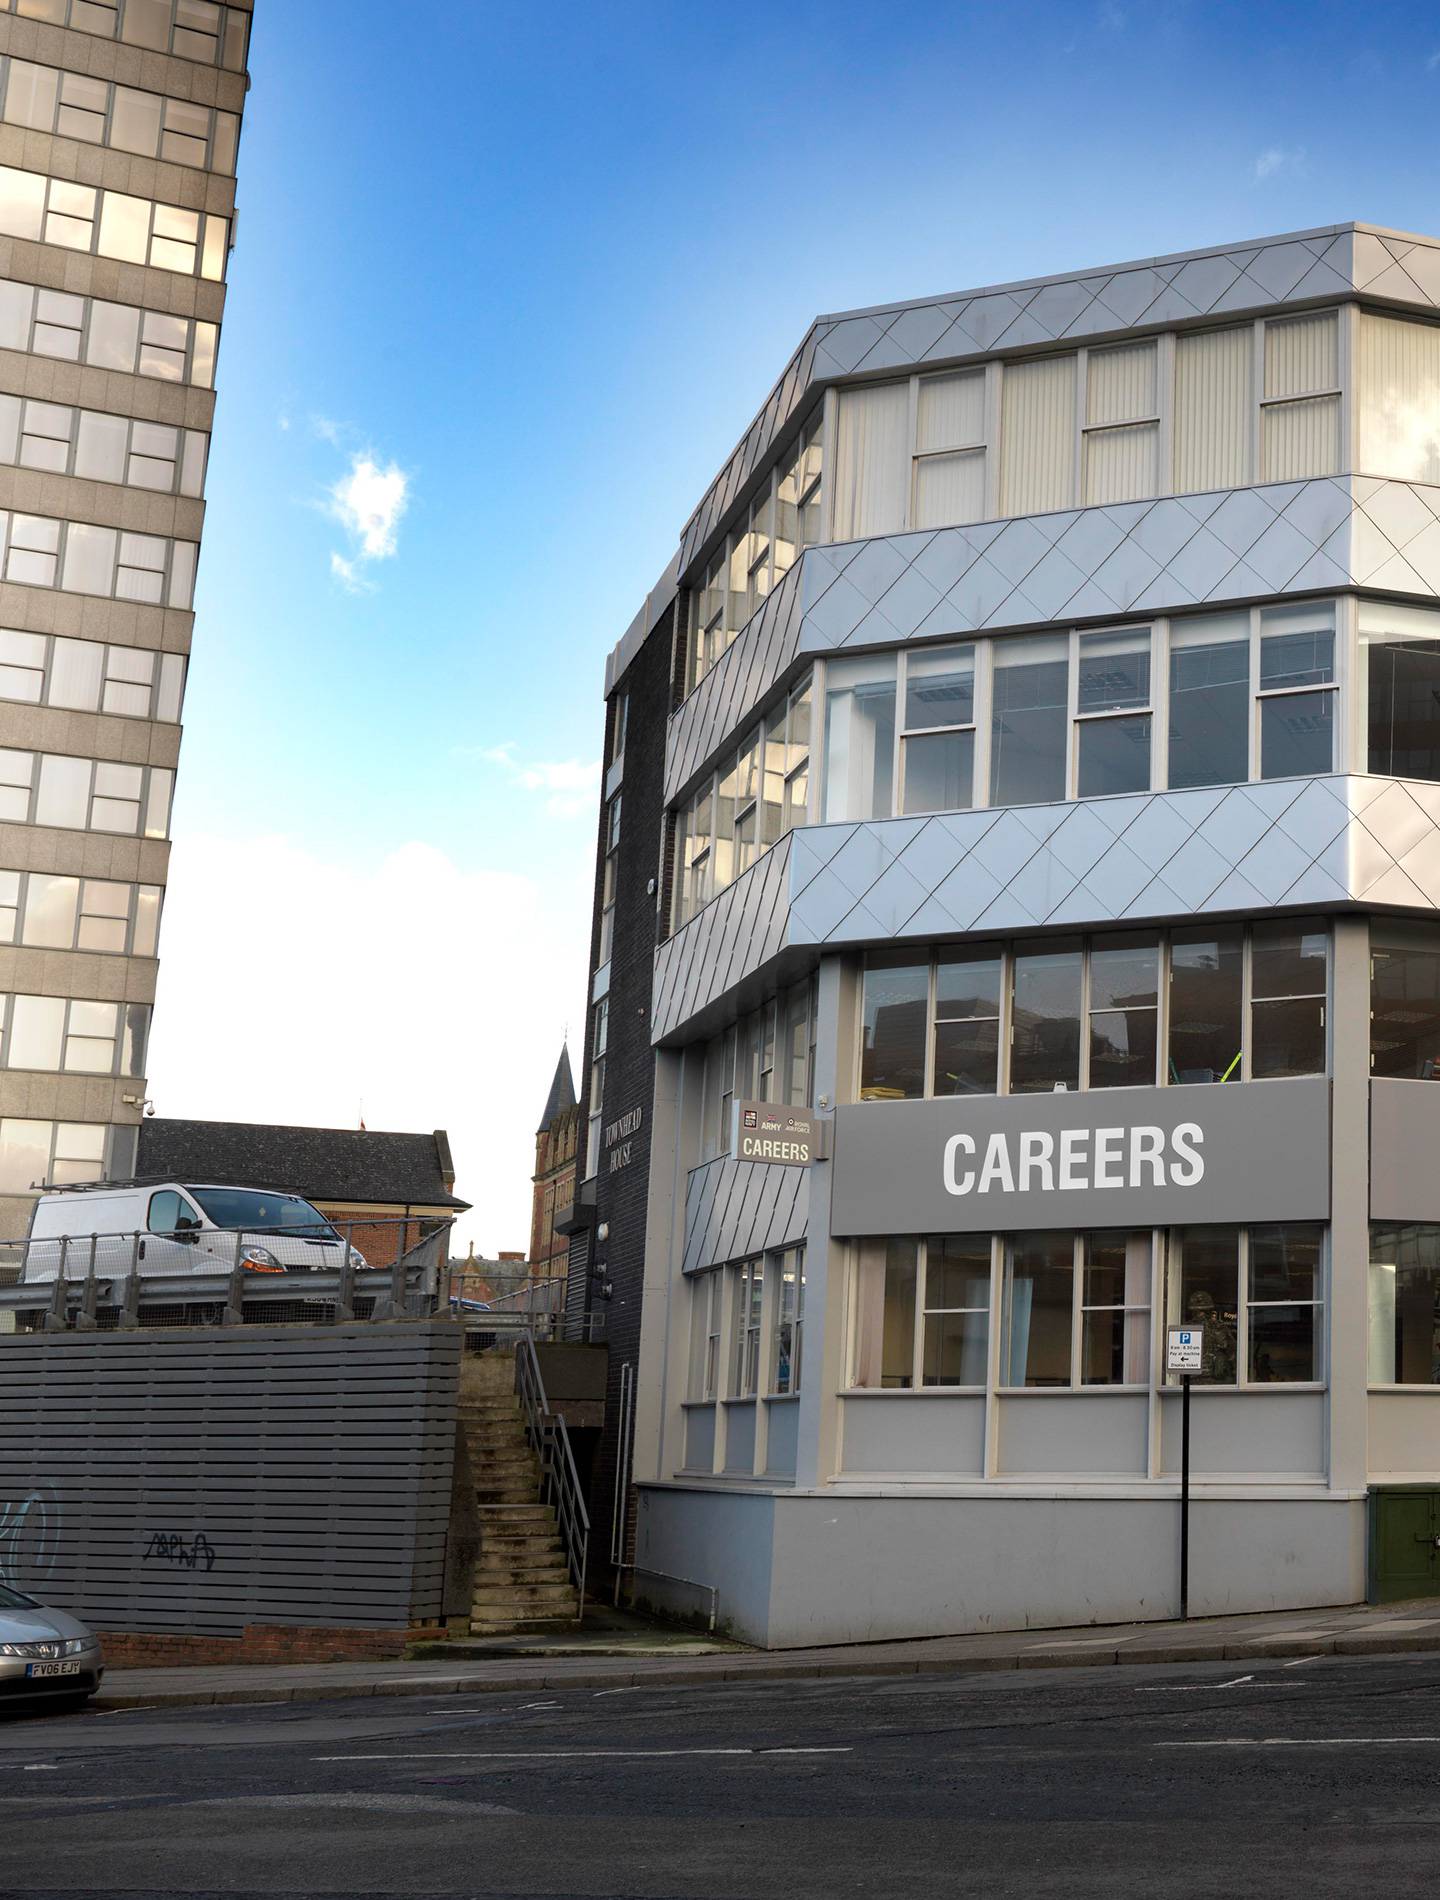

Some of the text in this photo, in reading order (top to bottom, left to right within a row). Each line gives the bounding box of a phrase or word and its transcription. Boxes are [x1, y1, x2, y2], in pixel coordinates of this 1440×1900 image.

[605, 1106, 642, 1148] TOWNHEAD
[760, 1122, 782, 1131] ARMY
[610, 1141, 632, 1174] HOUSE
[743, 1138, 809, 1162] CAREERS
[943, 1122, 1205, 1196] CAREERS
